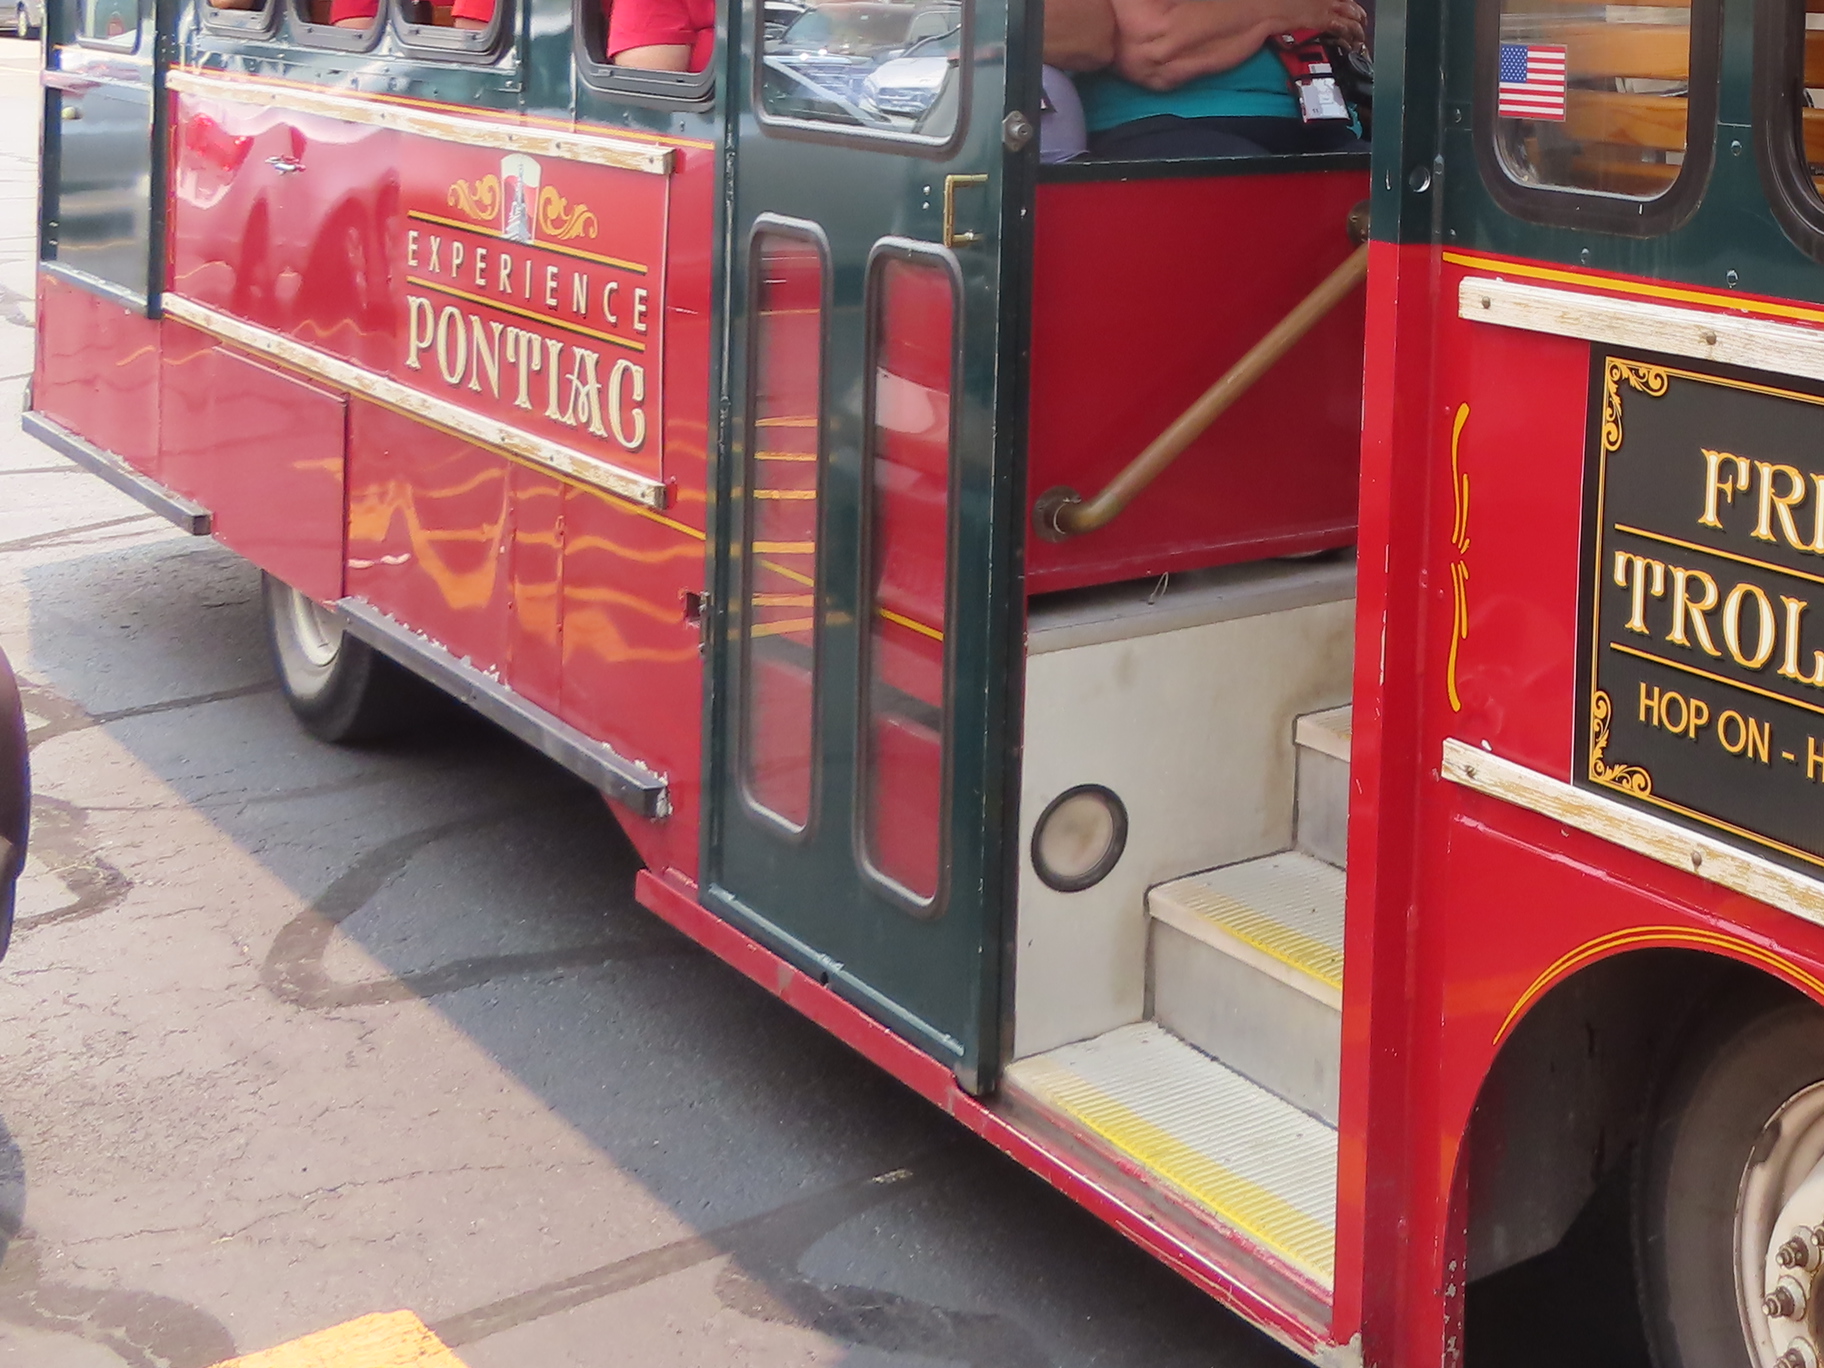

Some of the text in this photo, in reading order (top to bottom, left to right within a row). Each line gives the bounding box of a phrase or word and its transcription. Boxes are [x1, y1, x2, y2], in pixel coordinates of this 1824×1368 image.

[407, 230, 648, 332] EXPERIENCE
[404, 294, 646, 453] PONTIAC
[1638, 681, 1710, 738] HOP
[1716, 708, 1771, 764] ON
